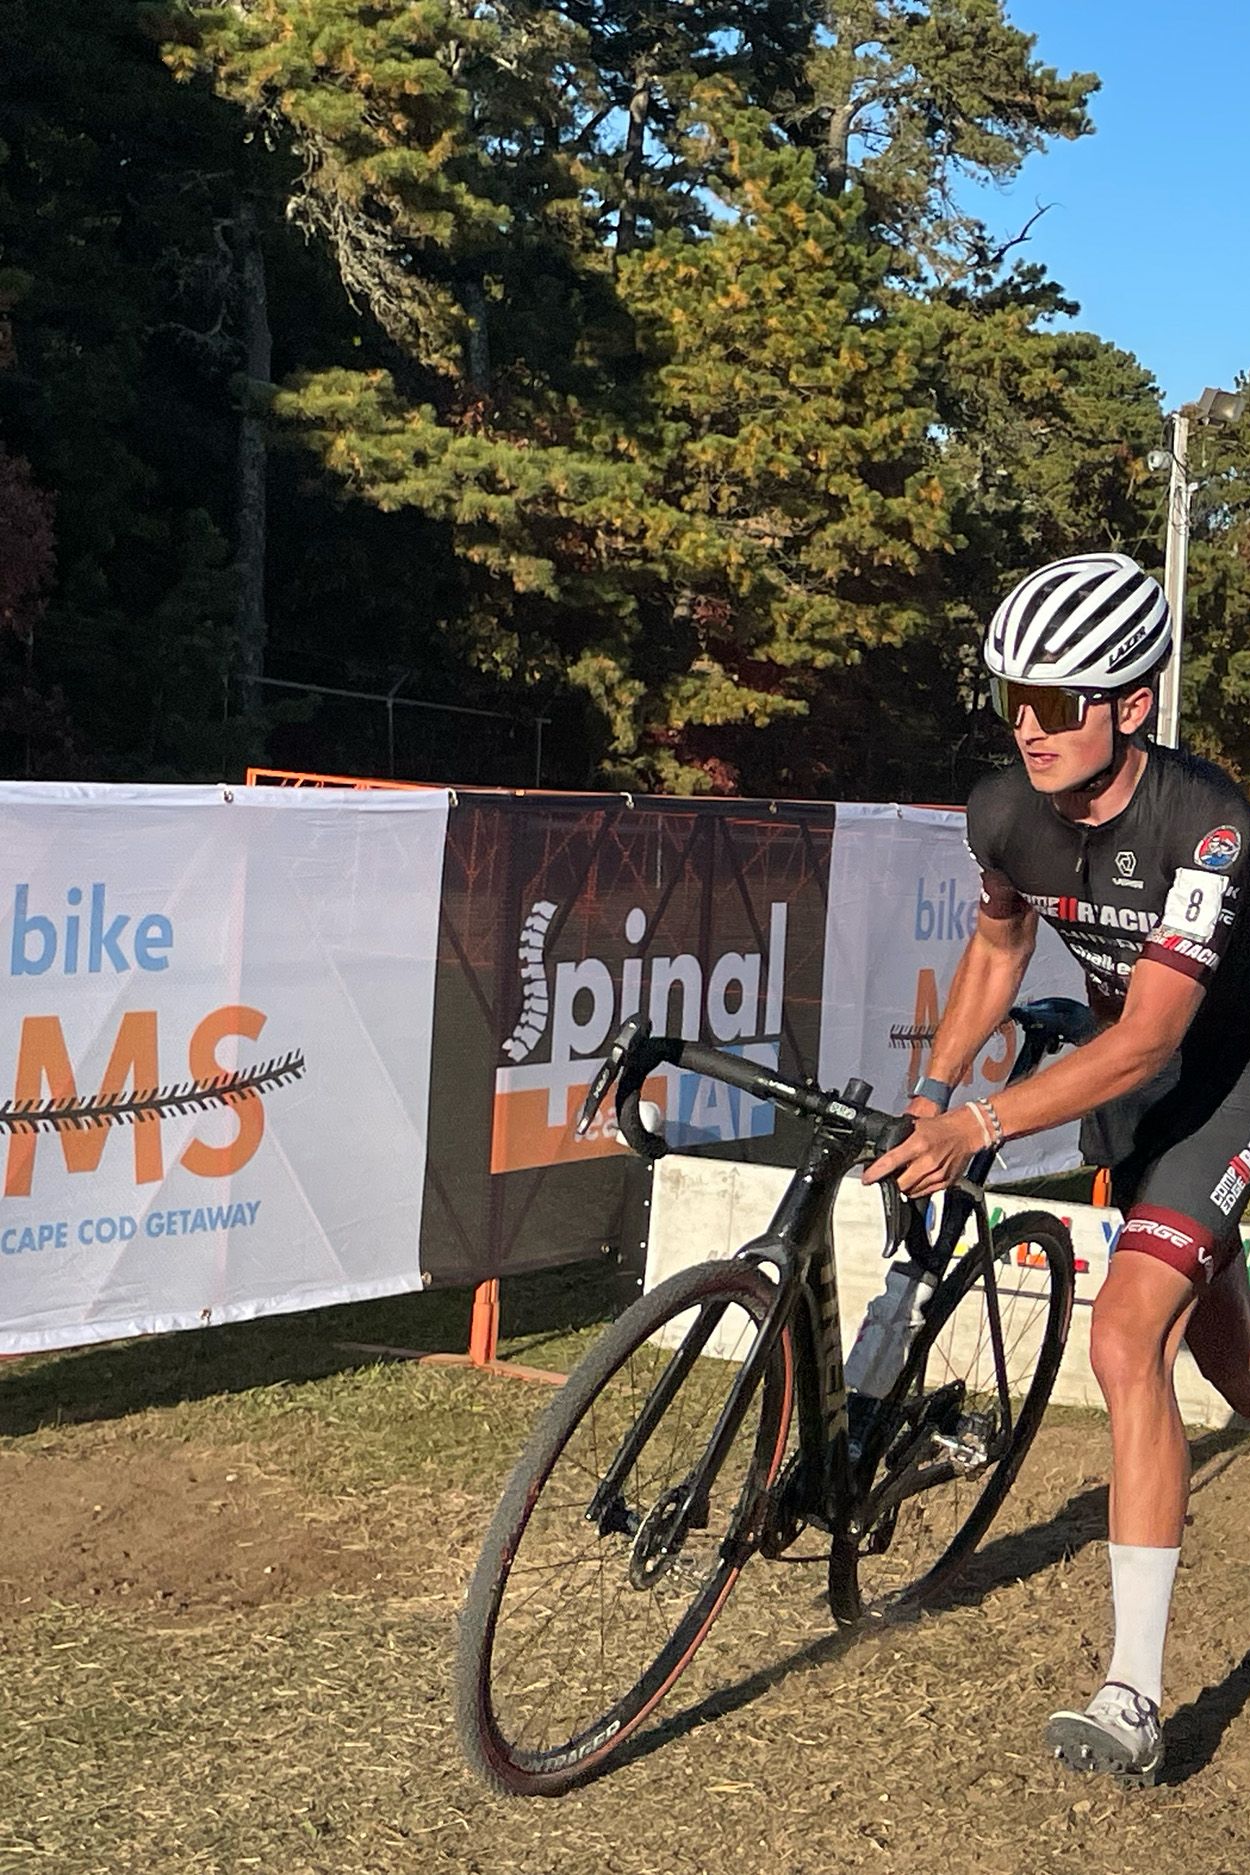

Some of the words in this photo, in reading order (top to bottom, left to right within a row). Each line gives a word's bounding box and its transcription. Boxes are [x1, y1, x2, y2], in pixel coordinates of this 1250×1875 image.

[1185, 888, 1204, 922] 8
[10, 883, 174, 976] bike
[4, 1004, 268, 1197] MS
[1210, 1166, 1237, 1206] COMP
[1220, 1176, 1246, 1216] EDGE
[1, 1222, 68, 1256] CAPE
[78, 1215, 138, 1246] COD
[145, 1200, 262, 1239] GETAWAY
